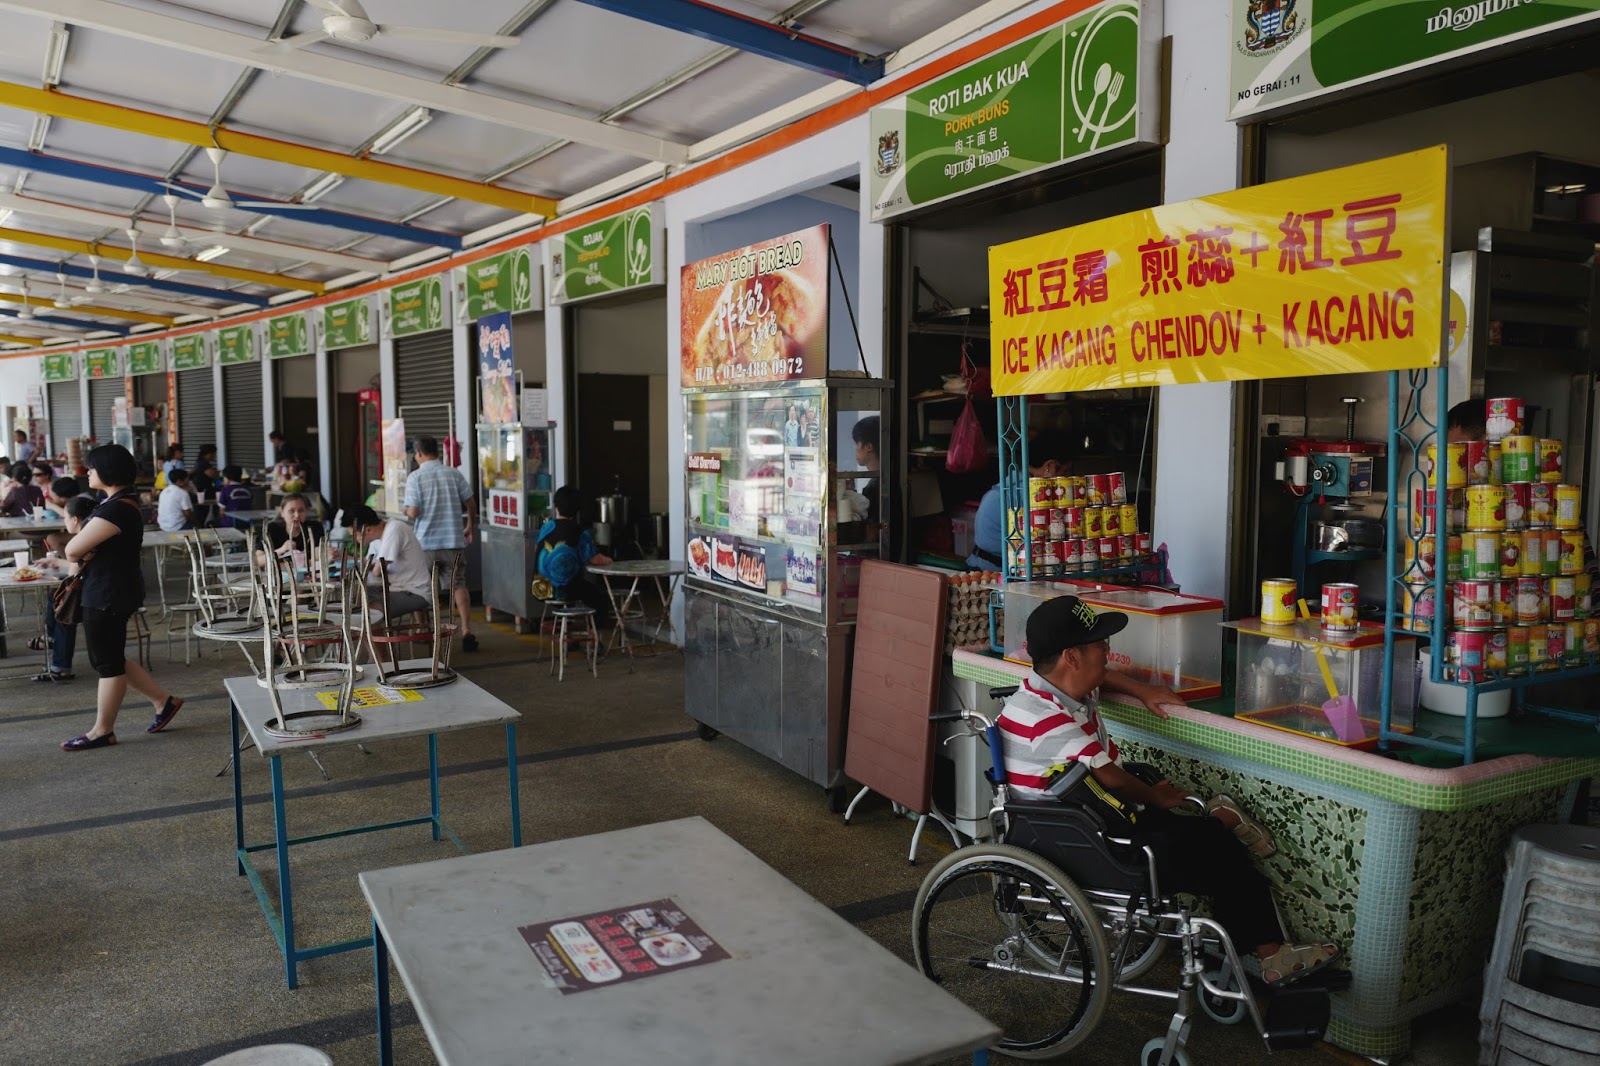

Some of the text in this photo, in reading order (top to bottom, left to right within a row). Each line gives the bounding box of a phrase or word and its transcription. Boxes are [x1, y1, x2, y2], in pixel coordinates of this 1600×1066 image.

[929, 60, 1030, 117] ROTI BAK KUA
[1237, 89, 1251, 101] NO
[1253, 80, 1281, 96] GERAI
[1289, 74, 1301, 86] 11
[945, 100, 1010, 136] PORK BUNS
[695, 240, 803, 291] MARY HOT BREAD
[1003, 249, 1109, 318] 紅豆霜
[1003, 337, 1029, 375] ICE
[1036, 324, 1117, 372] KACANG
[1130, 309, 1242, 363] CHENDOV
[1282, 288, 1414, 349] KACANG
[695, 366, 713, 382] H/P
[723, 361, 768, 379] 012-488
[771, 357, 803, 375] 0972
